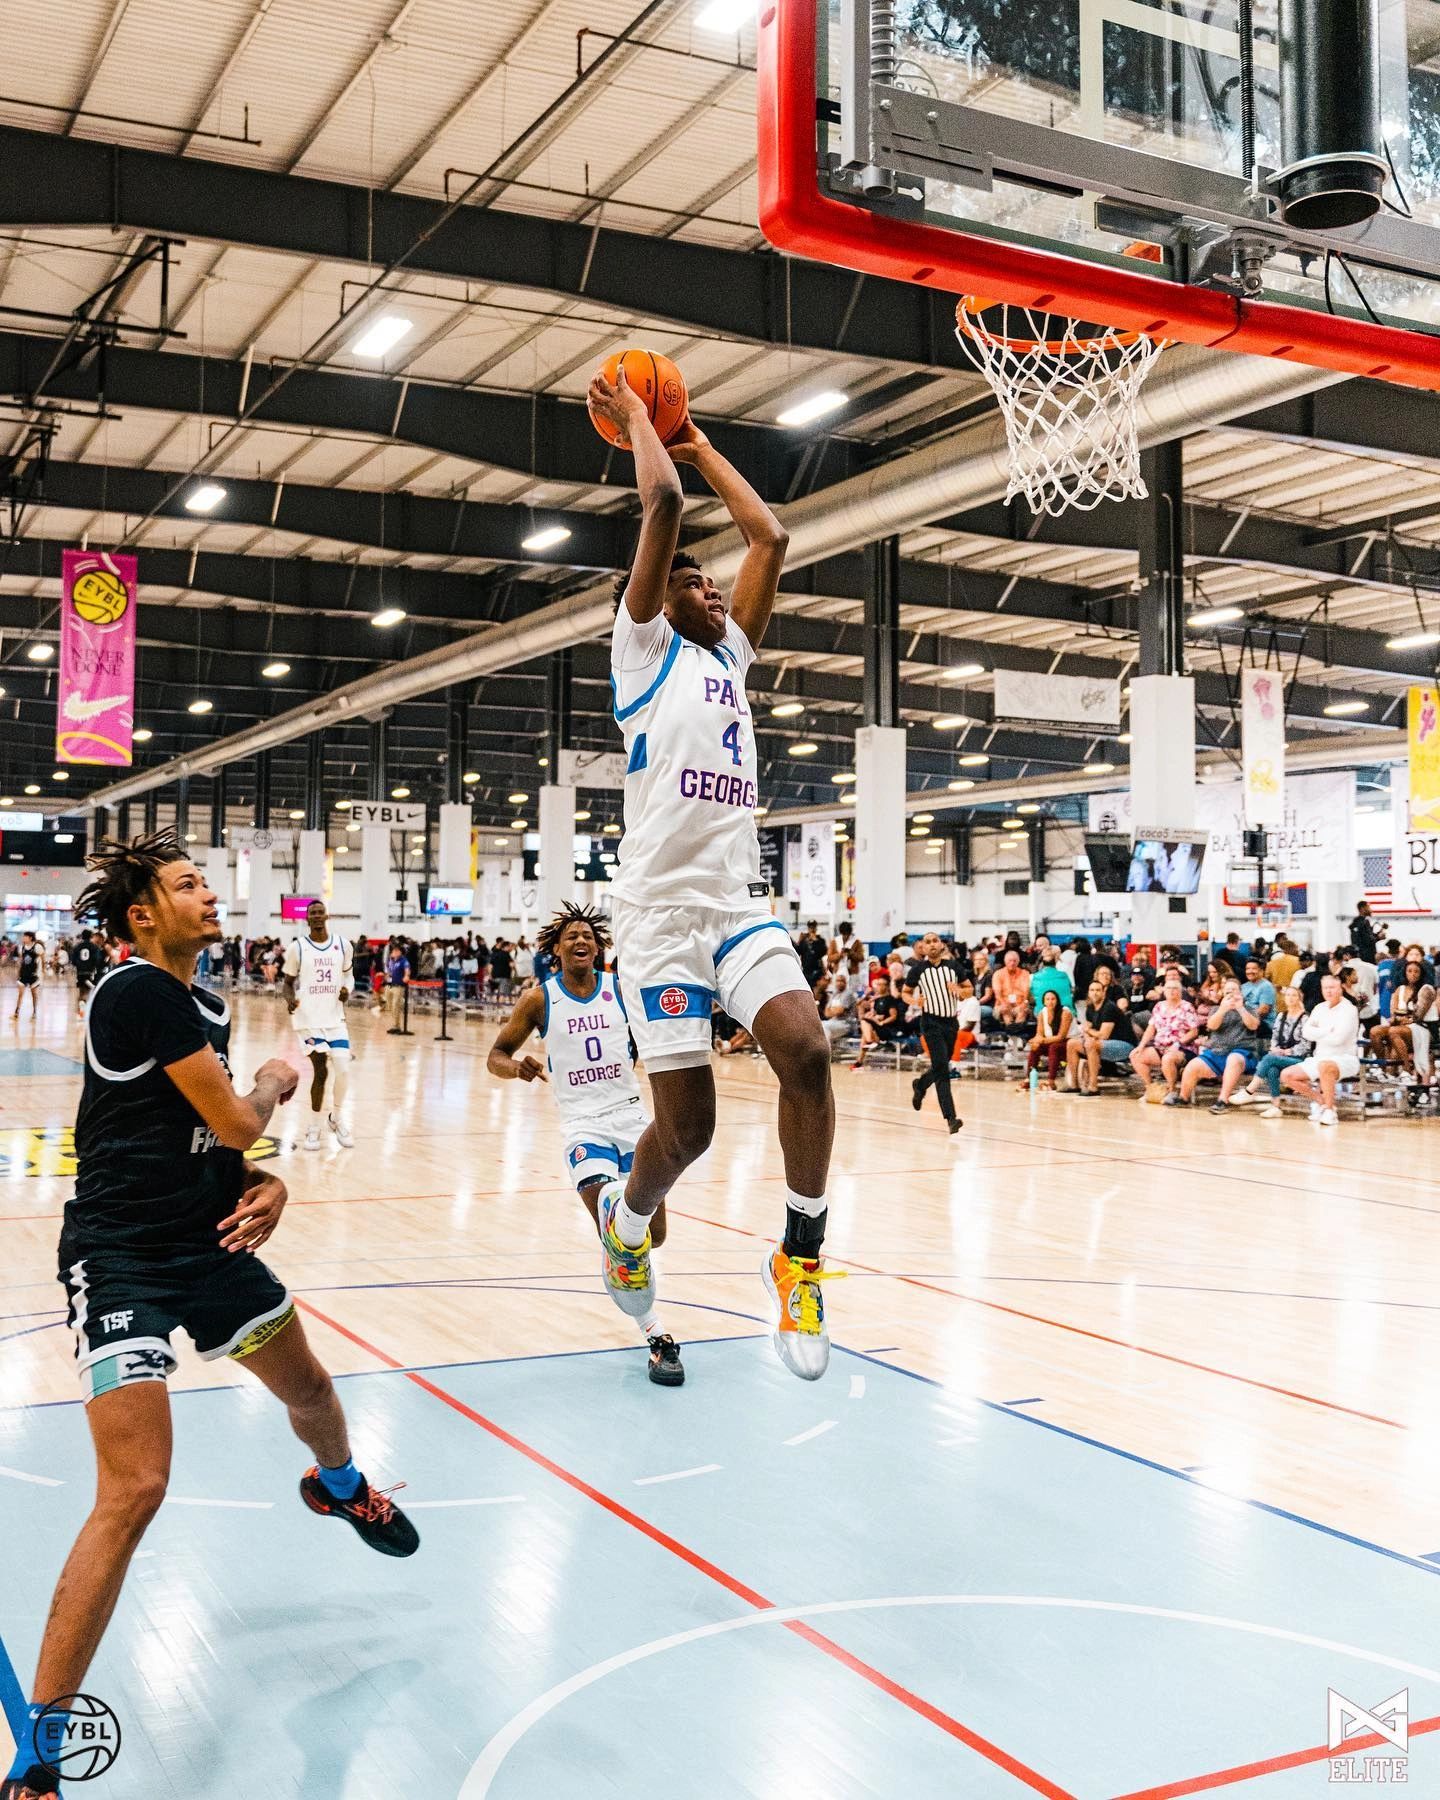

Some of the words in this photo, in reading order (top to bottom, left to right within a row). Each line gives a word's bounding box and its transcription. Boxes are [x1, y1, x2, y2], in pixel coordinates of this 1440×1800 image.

[84, 578, 121, 611] EYBL
[72, 647, 125, 665] NEVER
[75, 660, 122, 677] DONE
[722, 720, 742, 767] 4
[680, 768, 757, 810] GEORG
[352, 805, 405, 823] EYBL
[314, 958, 334, 967] PAUL
[316, 969, 332, 982] 34
[663, 995, 686, 1004] EYBL
[567, 1014, 610, 1034] PAUL
[584, 1036, 603, 1062] 0
[568, 1063, 622, 1087] GEORGE
[100, 1309, 134, 1334] TSF
